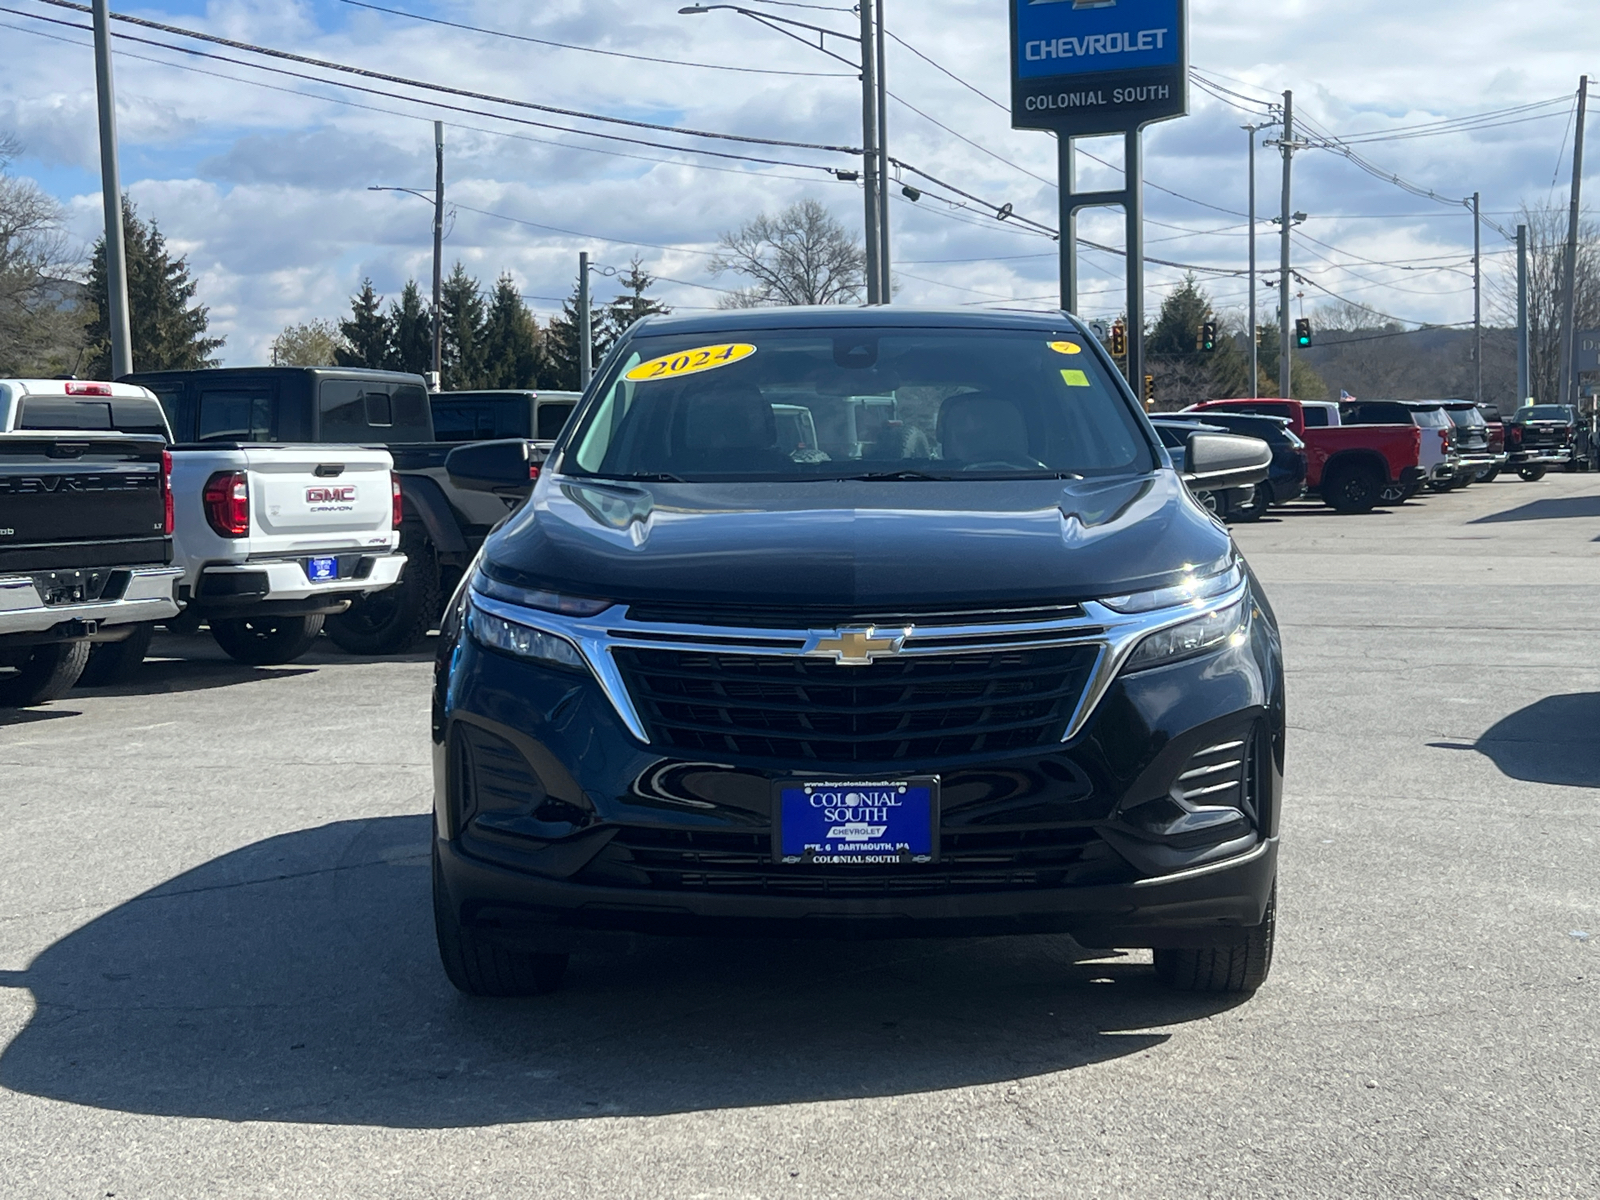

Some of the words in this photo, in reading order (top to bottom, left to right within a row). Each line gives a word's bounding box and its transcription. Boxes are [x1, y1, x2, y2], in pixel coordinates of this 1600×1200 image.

[1025, 28, 1168, 61] CHEVROLET
[1025, 90, 1107, 111] COLONIAL
[1113, 85, 1169, 104] SOUTH
[649, 345, 735, 377] 2024
[306, 487, 355, 503] GMC
[809, 792, 903, 807] COLONIAL
[824, 807, 888, 822] SOUTH
[832, 828, 882, 836] CHEVROLET
[825, 843, 832, 852] 6
[812, 855, 864, 864] COLONIAL
[865, 855, 900, 863] SOUTH
